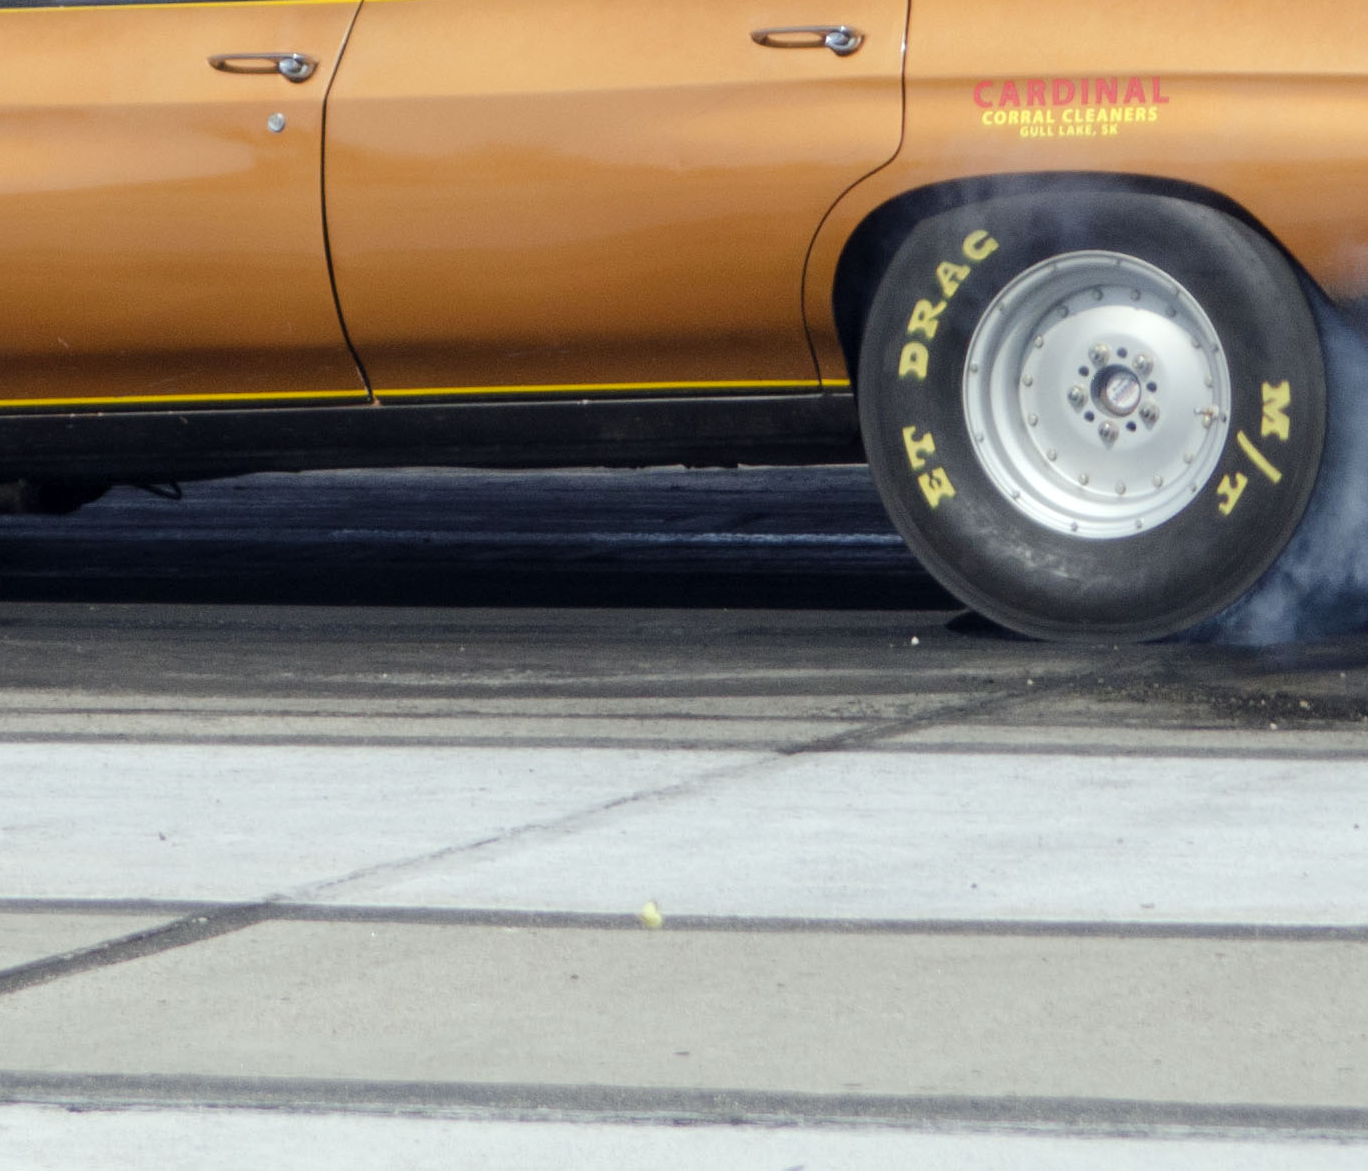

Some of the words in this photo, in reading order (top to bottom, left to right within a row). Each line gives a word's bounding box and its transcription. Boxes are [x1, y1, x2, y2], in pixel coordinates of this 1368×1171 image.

[973, 77, 1170, 108] CARDINAL
[982, 108, 1055, 125] CORRAL
[1061, 106, 1159, 124] CLEANERS
[1019, 125, 1055, 138] GULL
[1059, 124, 1097, 137] LAKE,
[1101, 124, 1119, 135] SK
[899, 229, 1000, 381] DRAG
[902, 425, 956, 509] ET
[1217, 380, 1291, 515] M/T
